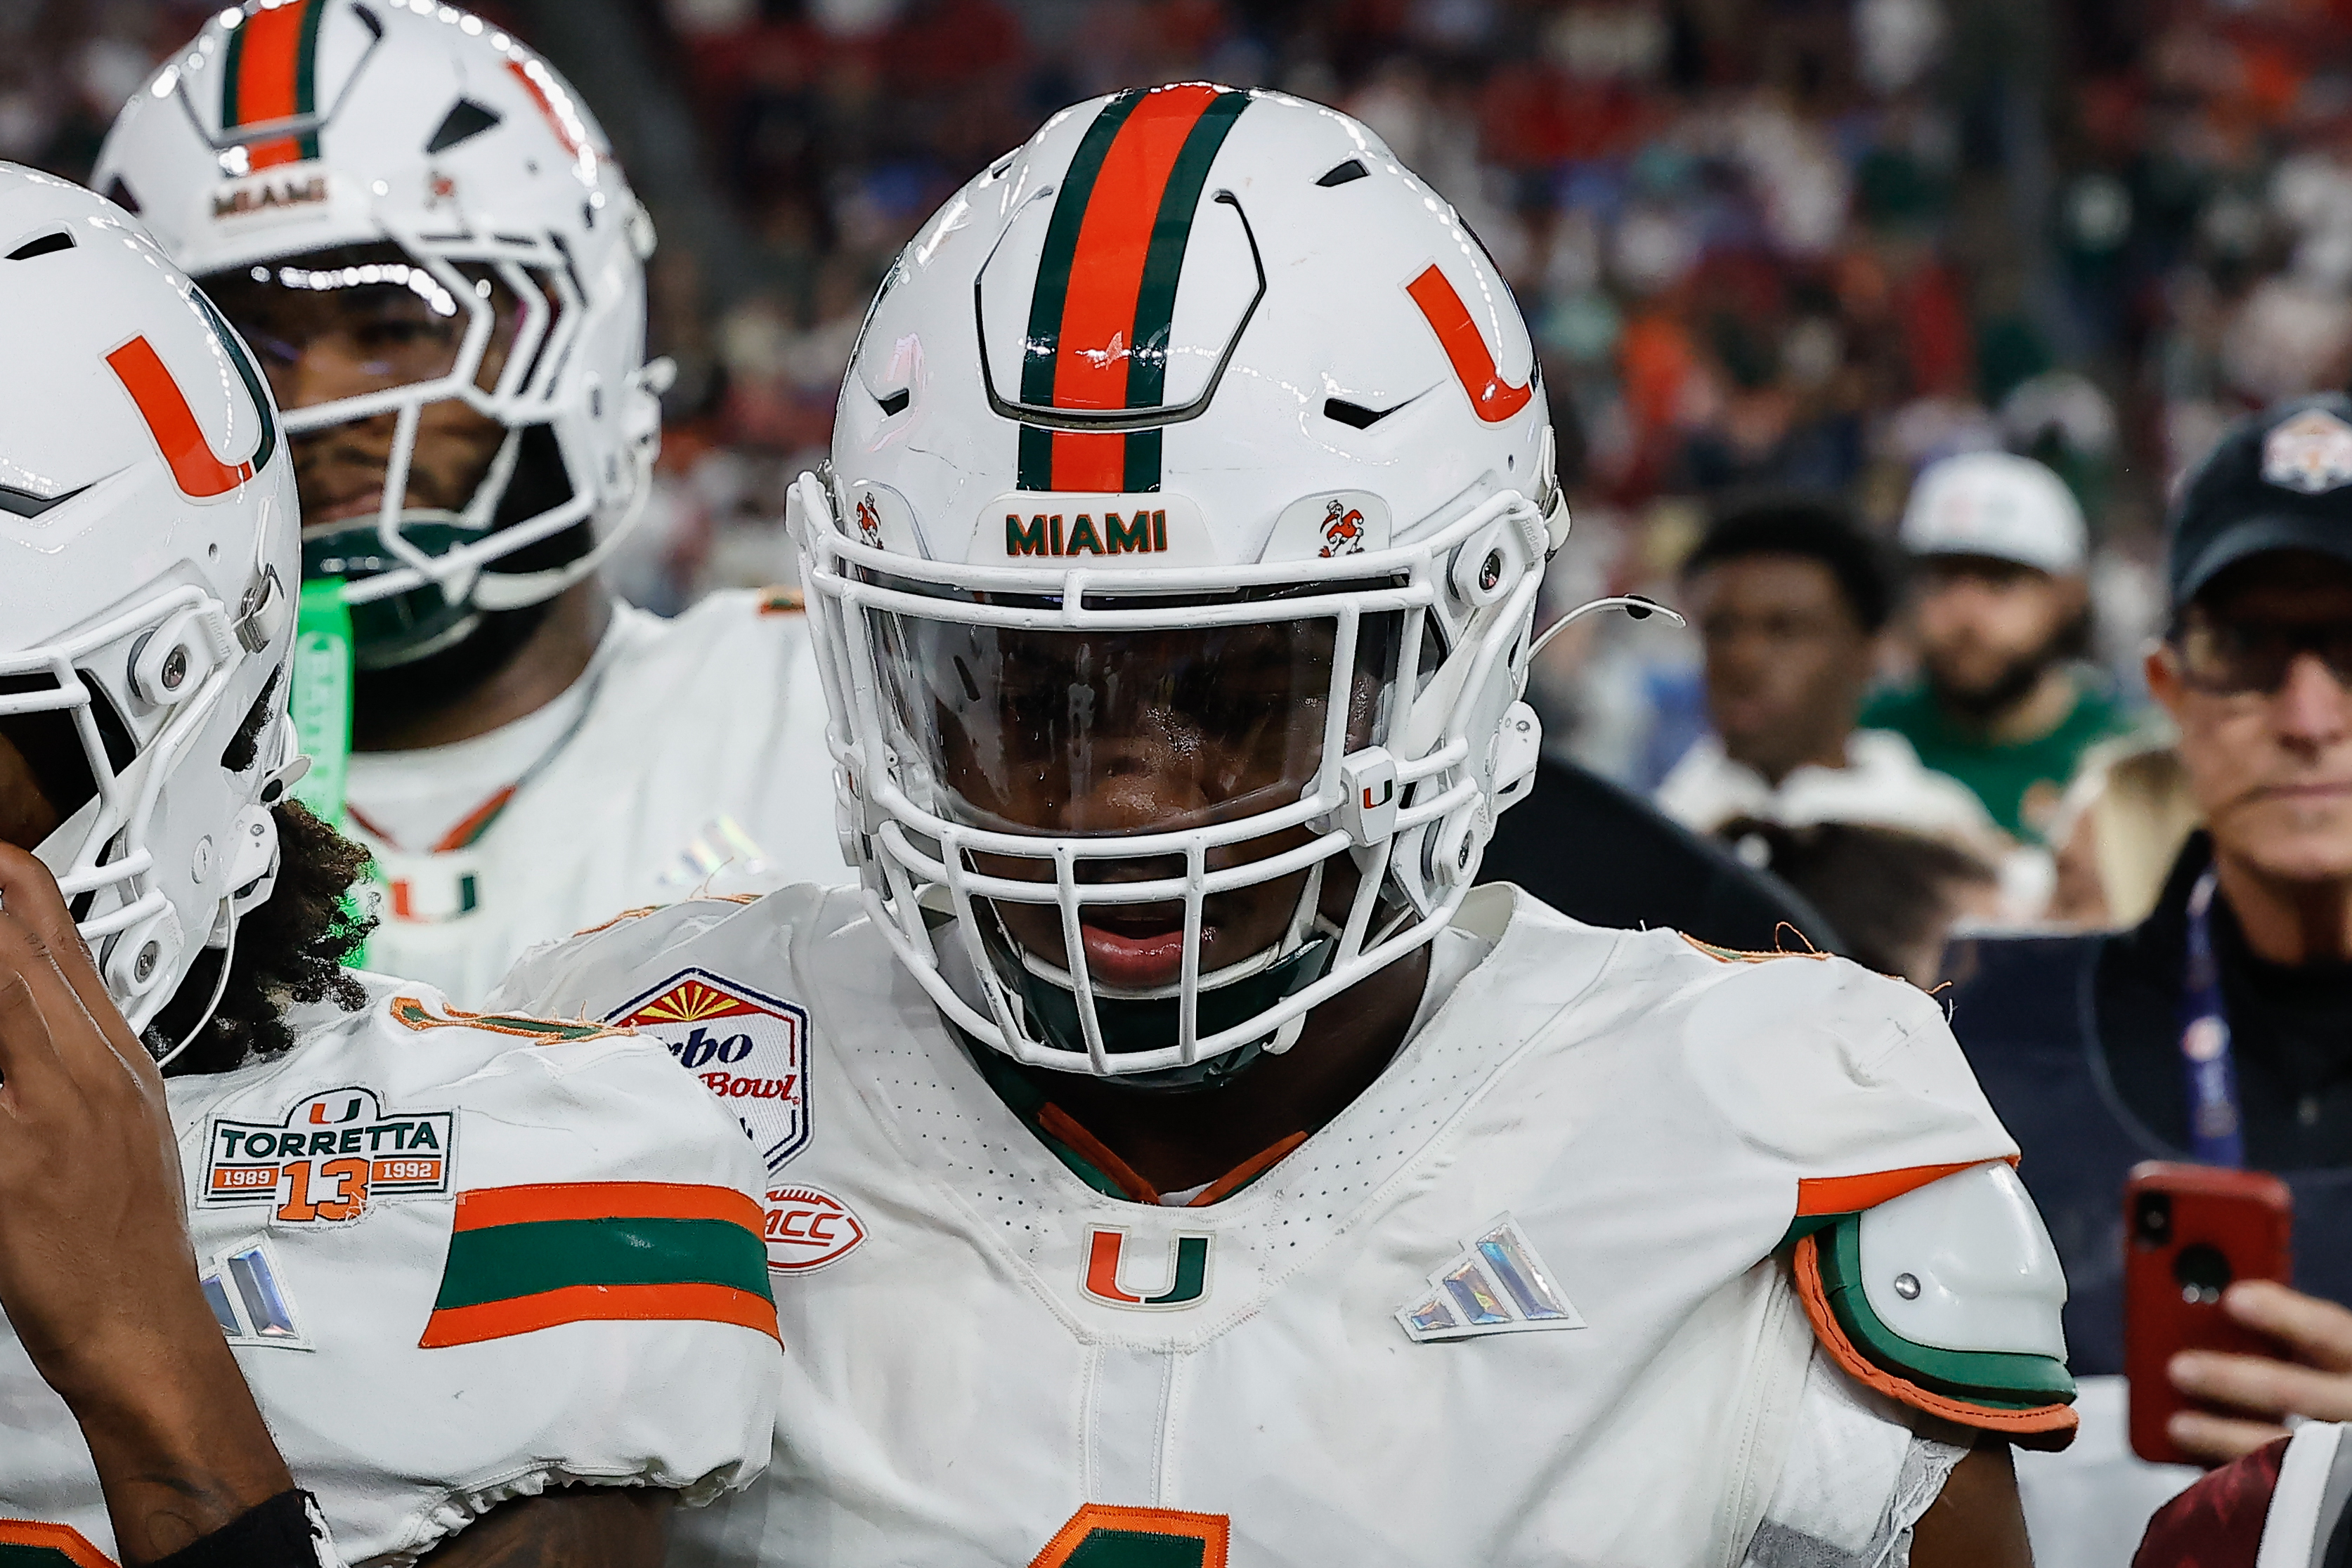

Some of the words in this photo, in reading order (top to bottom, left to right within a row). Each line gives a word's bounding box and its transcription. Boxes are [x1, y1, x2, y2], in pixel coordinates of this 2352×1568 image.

[213, 178, 327, 217] MIAMI
[105, 287, 275, 498] U
[1006, 509, 1167, 556] MIAMI
[1363, 778, 1393, 809] U
[390, 876, 479, 925] U
[658, 1027, 753, 1069] rbo
[699, 1072, 797, 1101] Bowl
[308, 1097, 362, 1124] U
[220, 1122, 440, 1158] TORRETTA
[223, 1170, 271, 1186] 1989
[277, 1156, 370, 1221] 13
[382, 1162, 432, 1179] 1992
[766, 1209, 845, 1240] ACC
[1086, 1230, 1208, 1305] U
